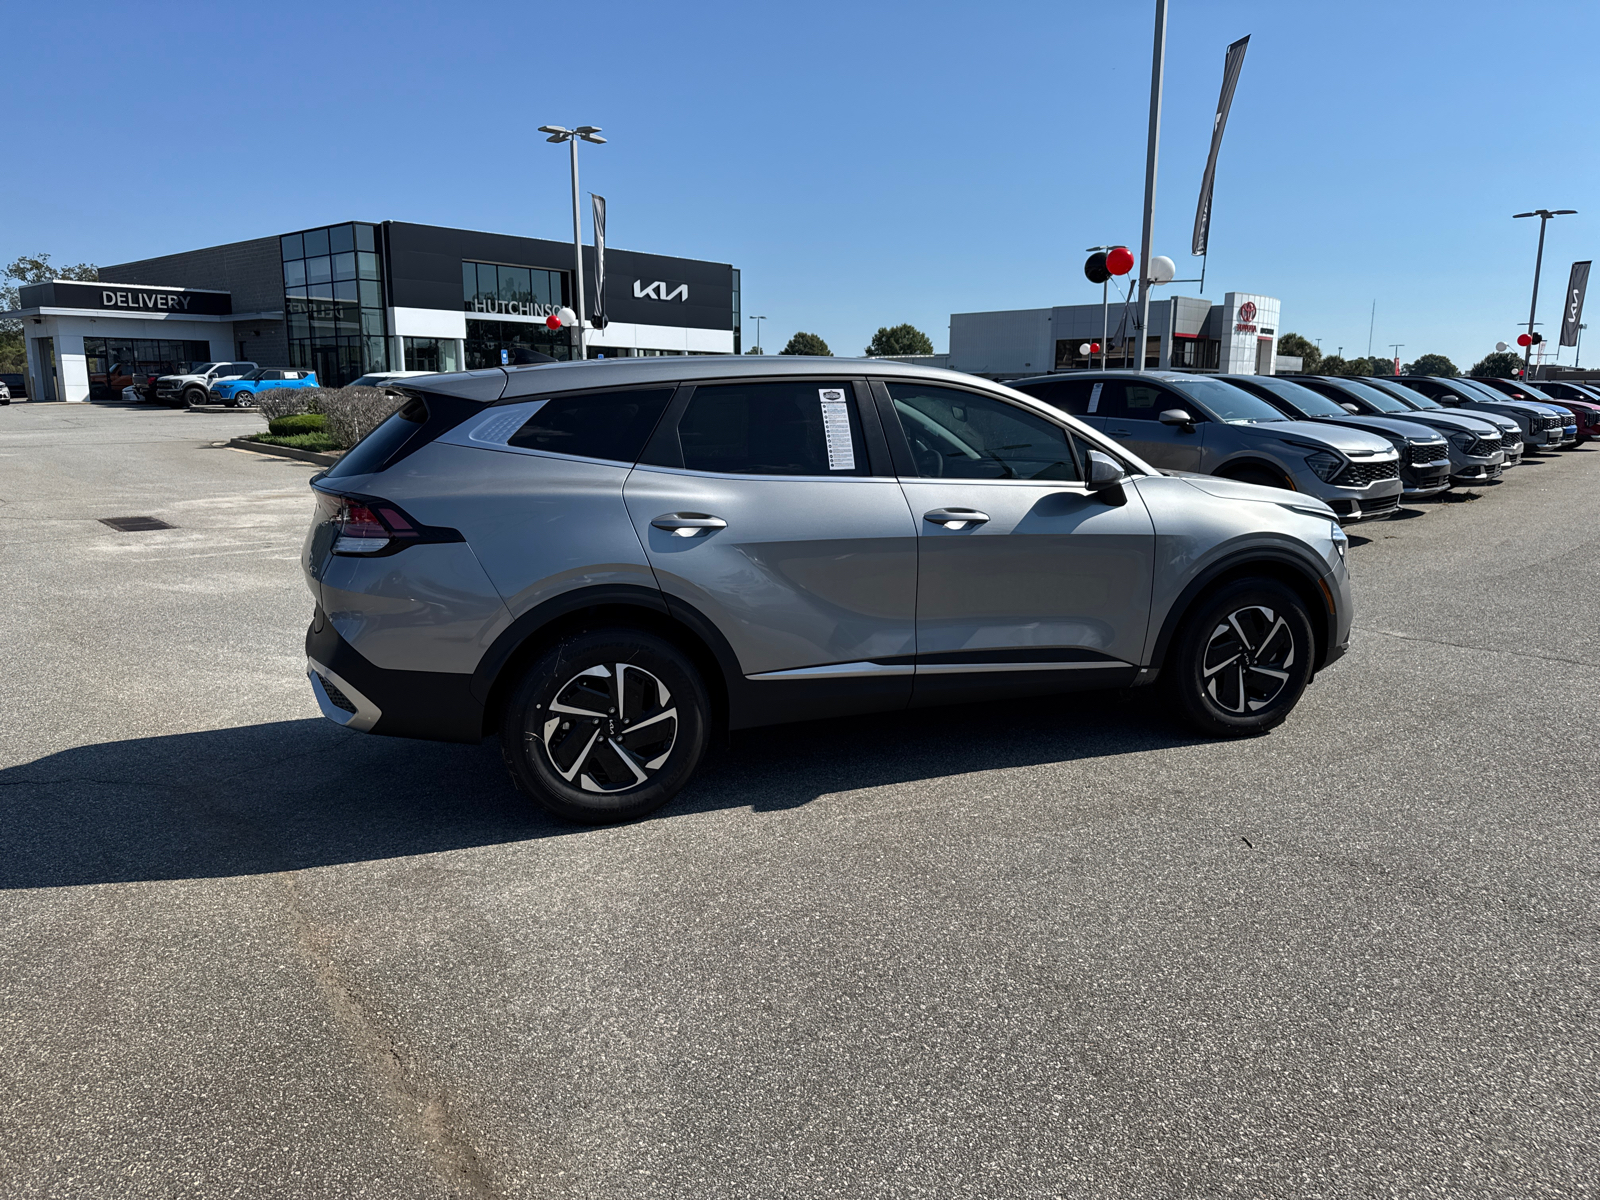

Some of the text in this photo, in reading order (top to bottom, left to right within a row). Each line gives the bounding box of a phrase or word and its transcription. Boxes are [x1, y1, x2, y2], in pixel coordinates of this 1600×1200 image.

[102, 290, 191, 310] DELIVERY
[633, 279, 689, 302] KIA
[475, 299, 571, 318] HUTCHINSO
